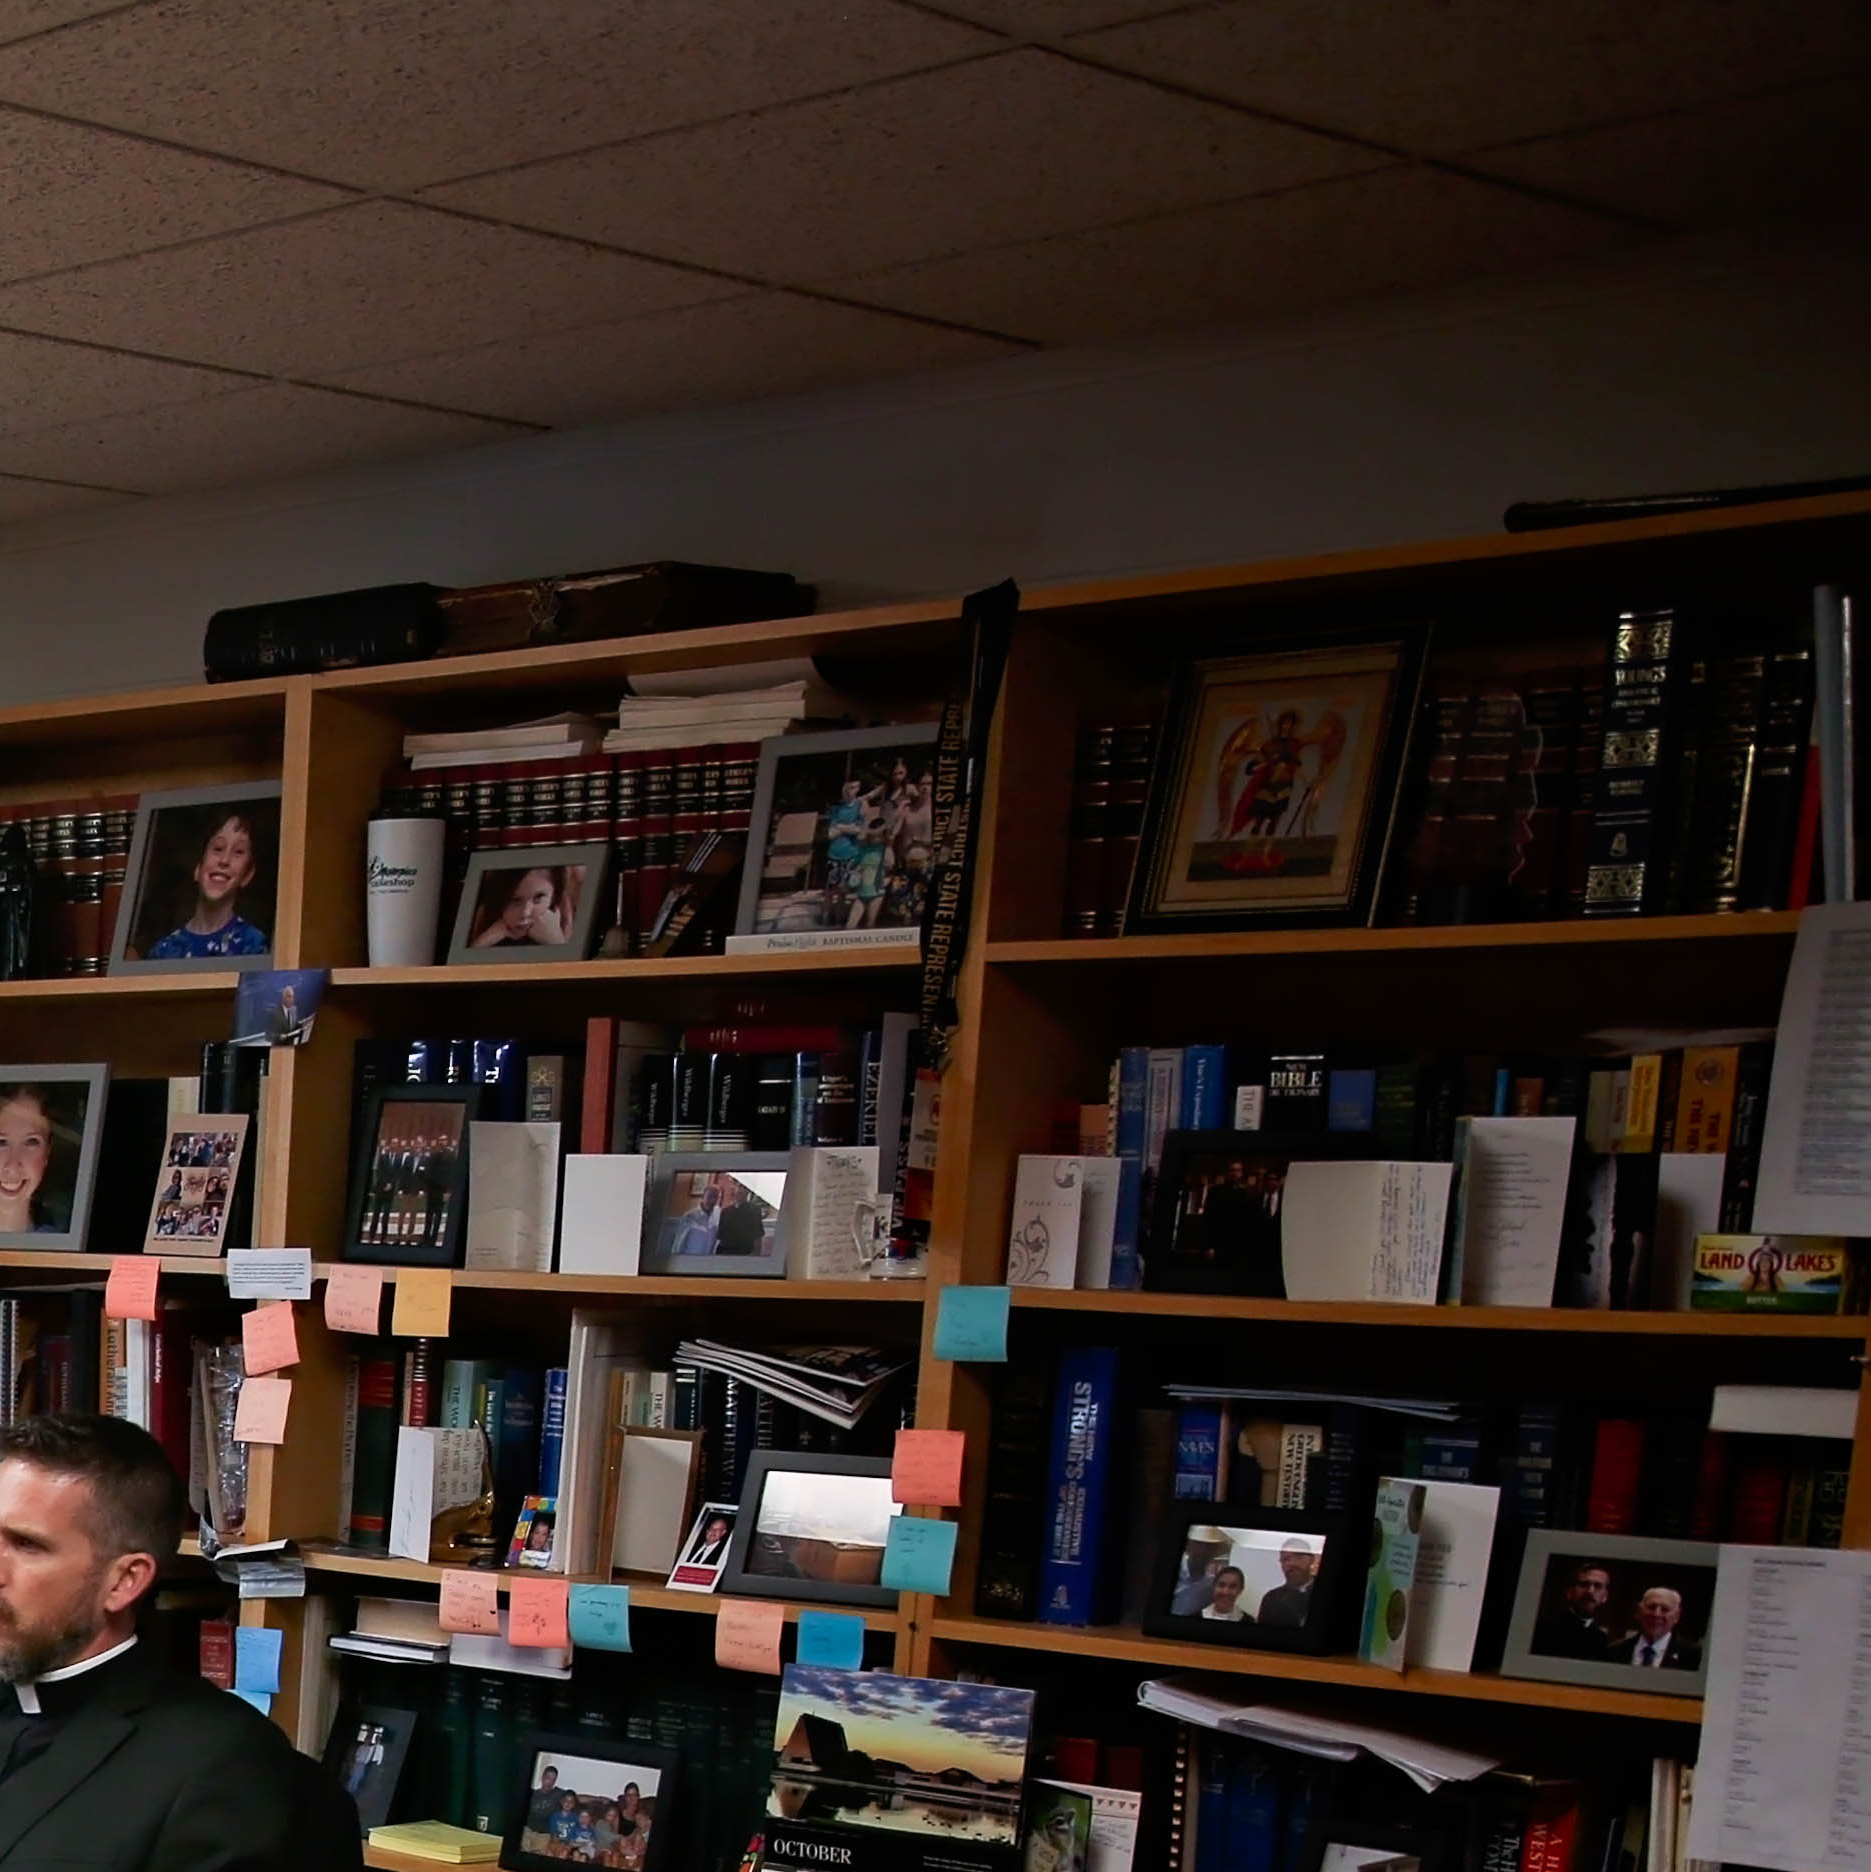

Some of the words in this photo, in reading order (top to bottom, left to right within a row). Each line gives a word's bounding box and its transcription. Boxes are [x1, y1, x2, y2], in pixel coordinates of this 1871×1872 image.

[935, 754, 959, 802] STATE
[936, 871, 961, 921] STATE
[1270, 1070, 1324, 1089] BIBLE
[1700, 1251, 1745, 1272] LAND
[1785, 1251, 1836, 1273] LAKES
[722, 1381, 739, 1475] MATTHEW
[1065, 1381, 1093, 1480] STRONG'S
[773, 1837, 853, 1865] OCTOBER
[1503, 1836, 1521, 1857] The
